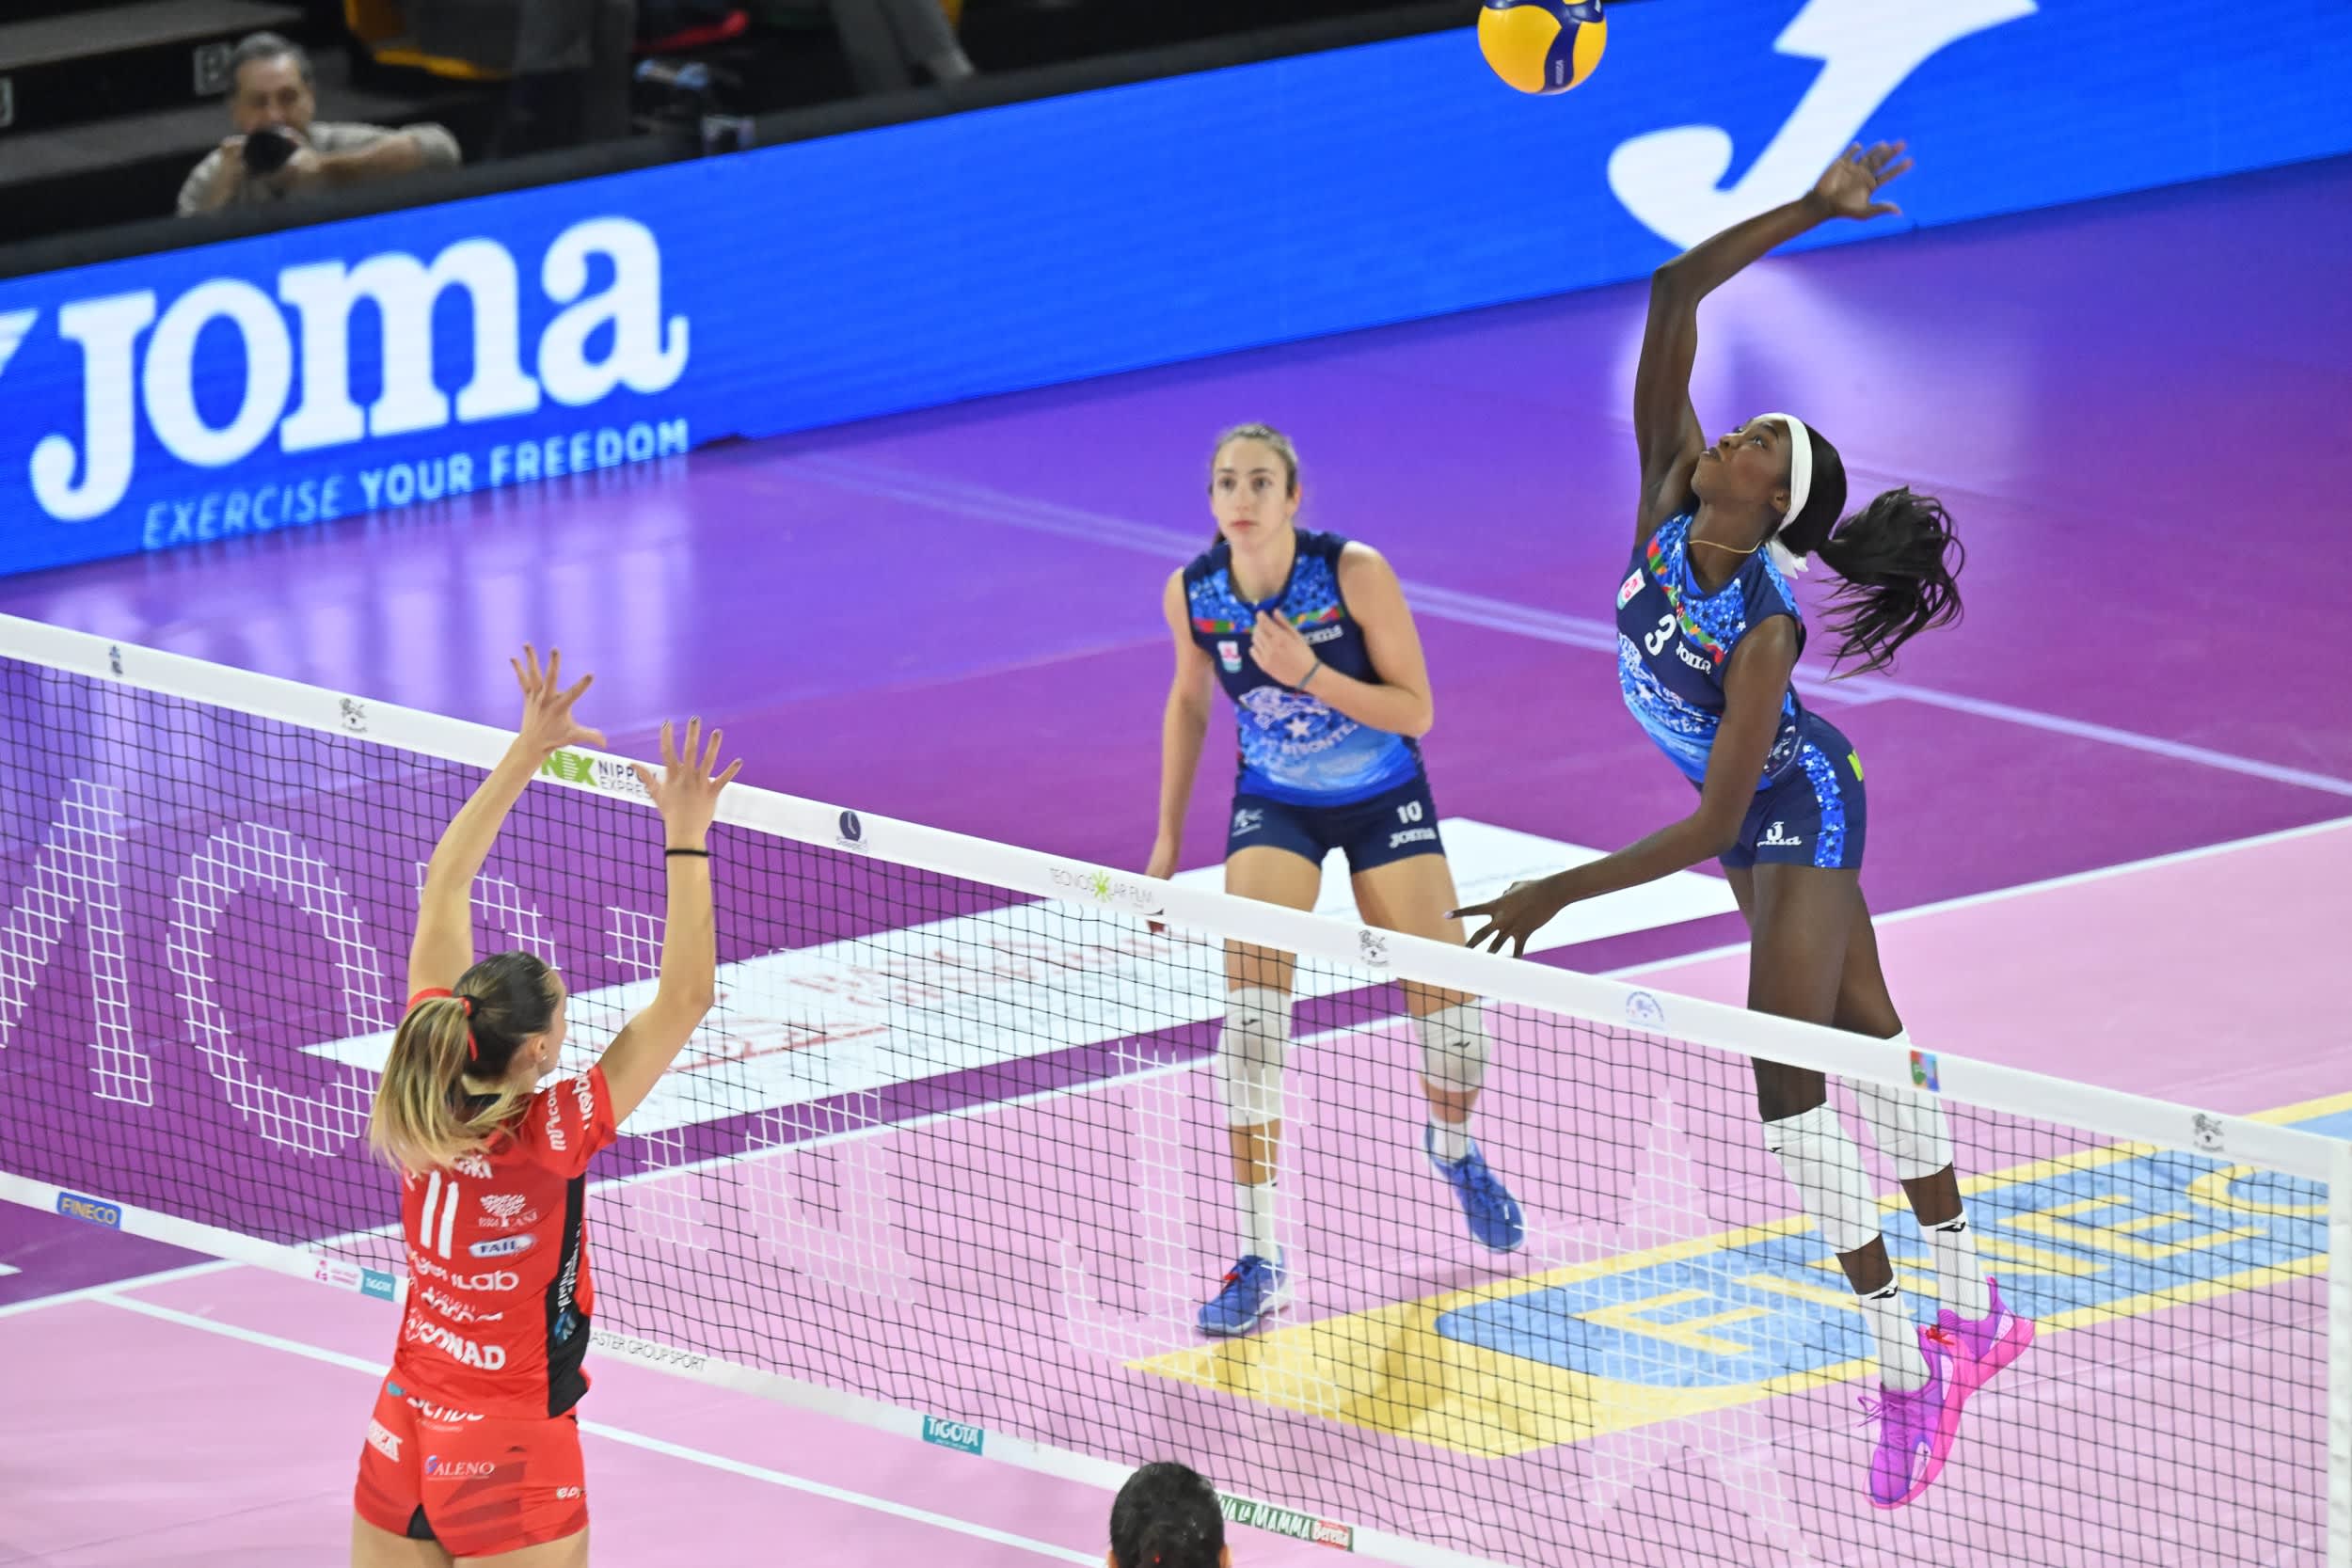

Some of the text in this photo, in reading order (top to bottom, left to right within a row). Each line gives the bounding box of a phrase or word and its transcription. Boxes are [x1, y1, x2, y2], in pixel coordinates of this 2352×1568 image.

[142, 418, 689, 550] EXERCISE YOUR FREEDOM
[1645, 614, 1677, 657] 3
[598, 759, 658, 784] NIPP
[1397, 800, 1422, 824] 10
[61, 1196, 119, 1226] FINECO
[421, 1170, 459, 1259] 11
[590, 1331, 707, 1371] ASTER GROUP SPORT
[1250, 1502, 1311, 1542] MAMMA
